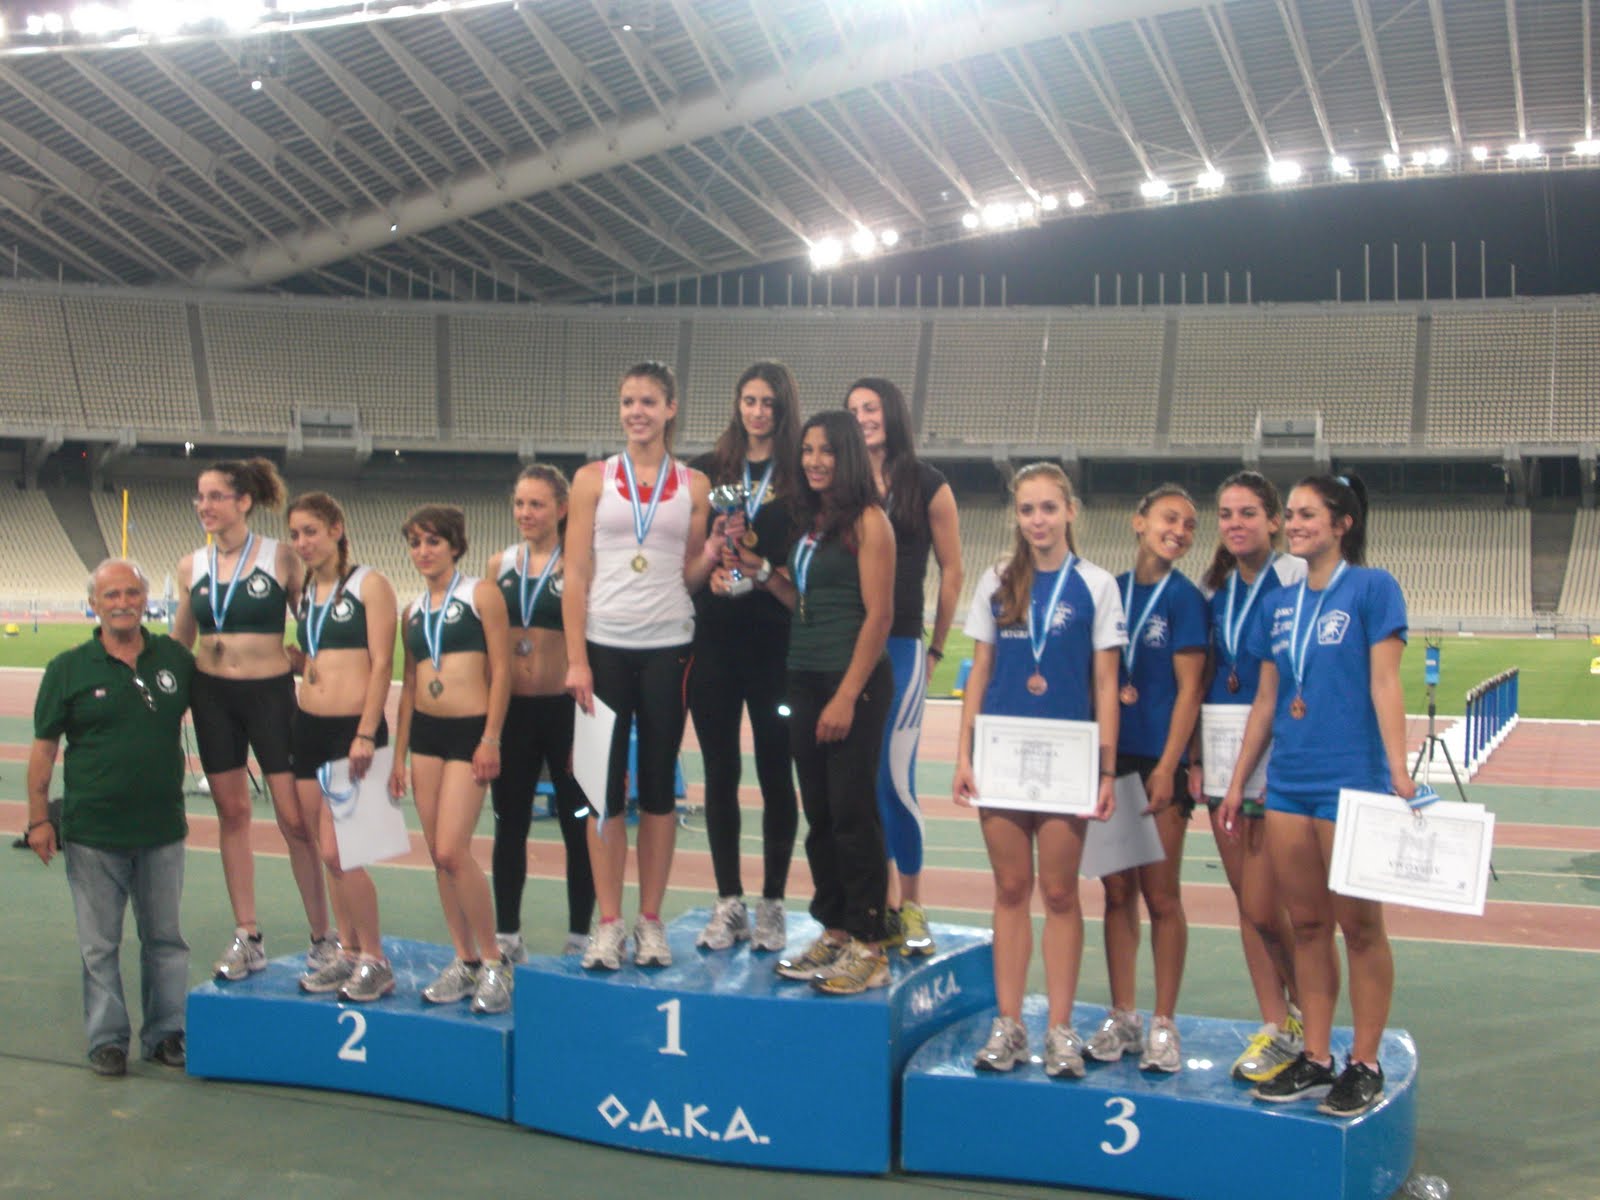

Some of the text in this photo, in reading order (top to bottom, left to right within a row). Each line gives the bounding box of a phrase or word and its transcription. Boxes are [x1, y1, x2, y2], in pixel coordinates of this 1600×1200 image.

[337, 1010, 367, 1062] 2
[657, 999, 687, 1056] 1
[1100, 1096, 1140, 1155] 3
